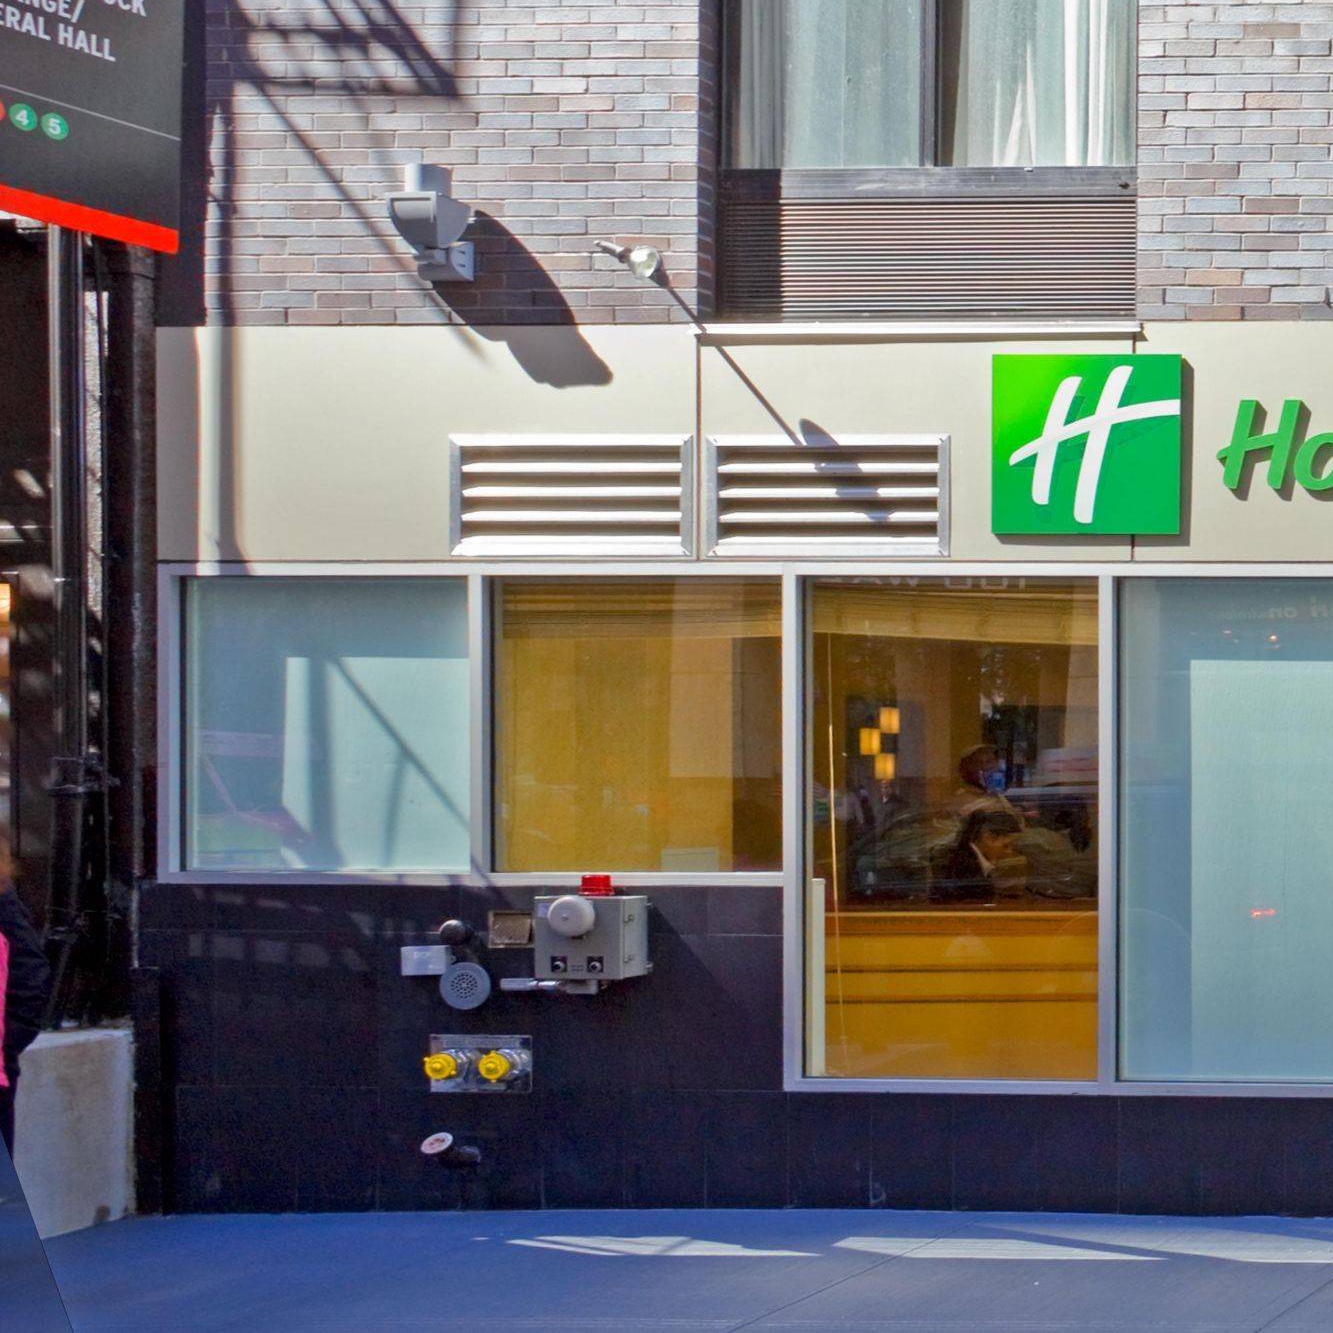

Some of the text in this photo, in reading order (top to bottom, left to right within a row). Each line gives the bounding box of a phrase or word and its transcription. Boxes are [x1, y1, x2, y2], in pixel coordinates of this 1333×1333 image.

[57, 23, 116, 62] HALL
[15, 109, 61, 135] 4 5
